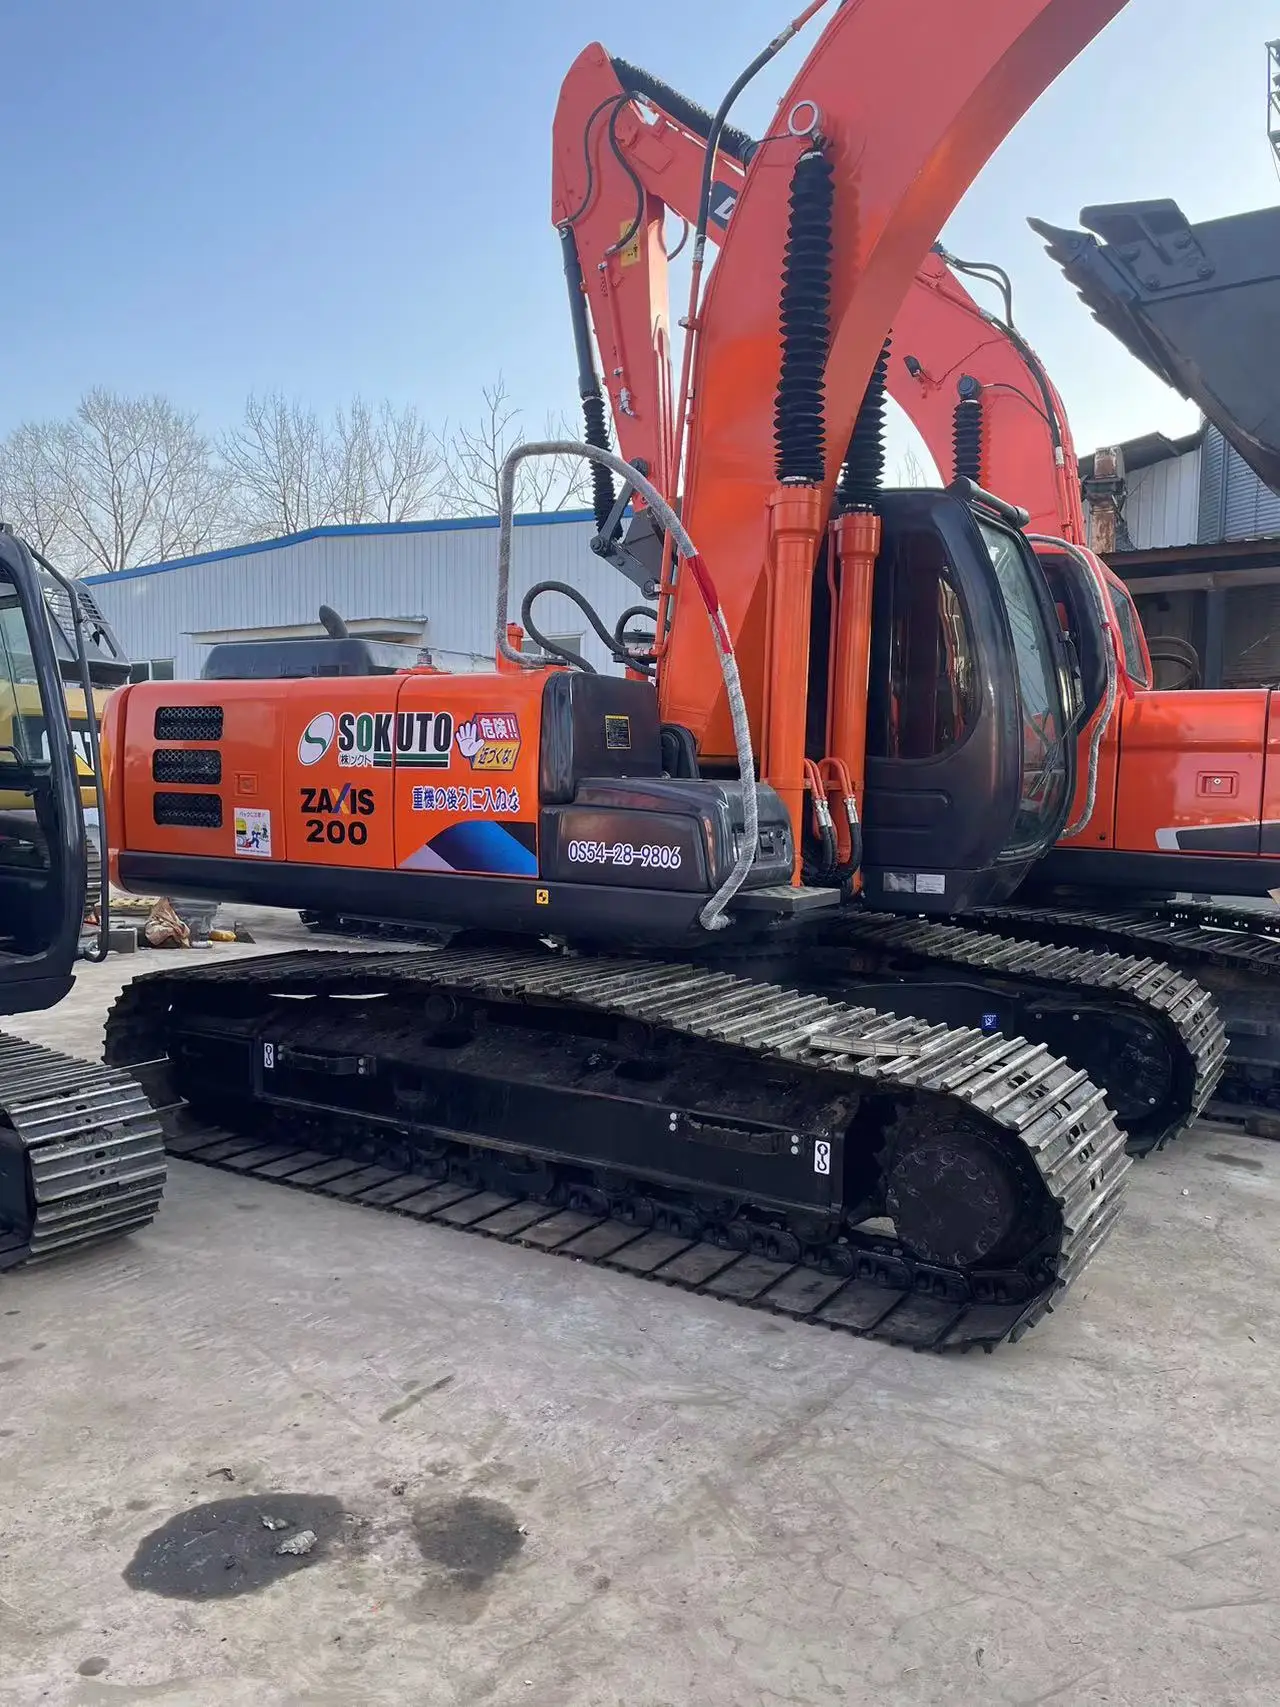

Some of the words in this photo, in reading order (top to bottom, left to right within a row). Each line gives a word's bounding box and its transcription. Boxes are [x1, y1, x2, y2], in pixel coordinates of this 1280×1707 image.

[338, 712, 453, 752] SOKUTO
[301, 783, 375, 815] ZAXIS
[306, 819, 367, 845] 200
